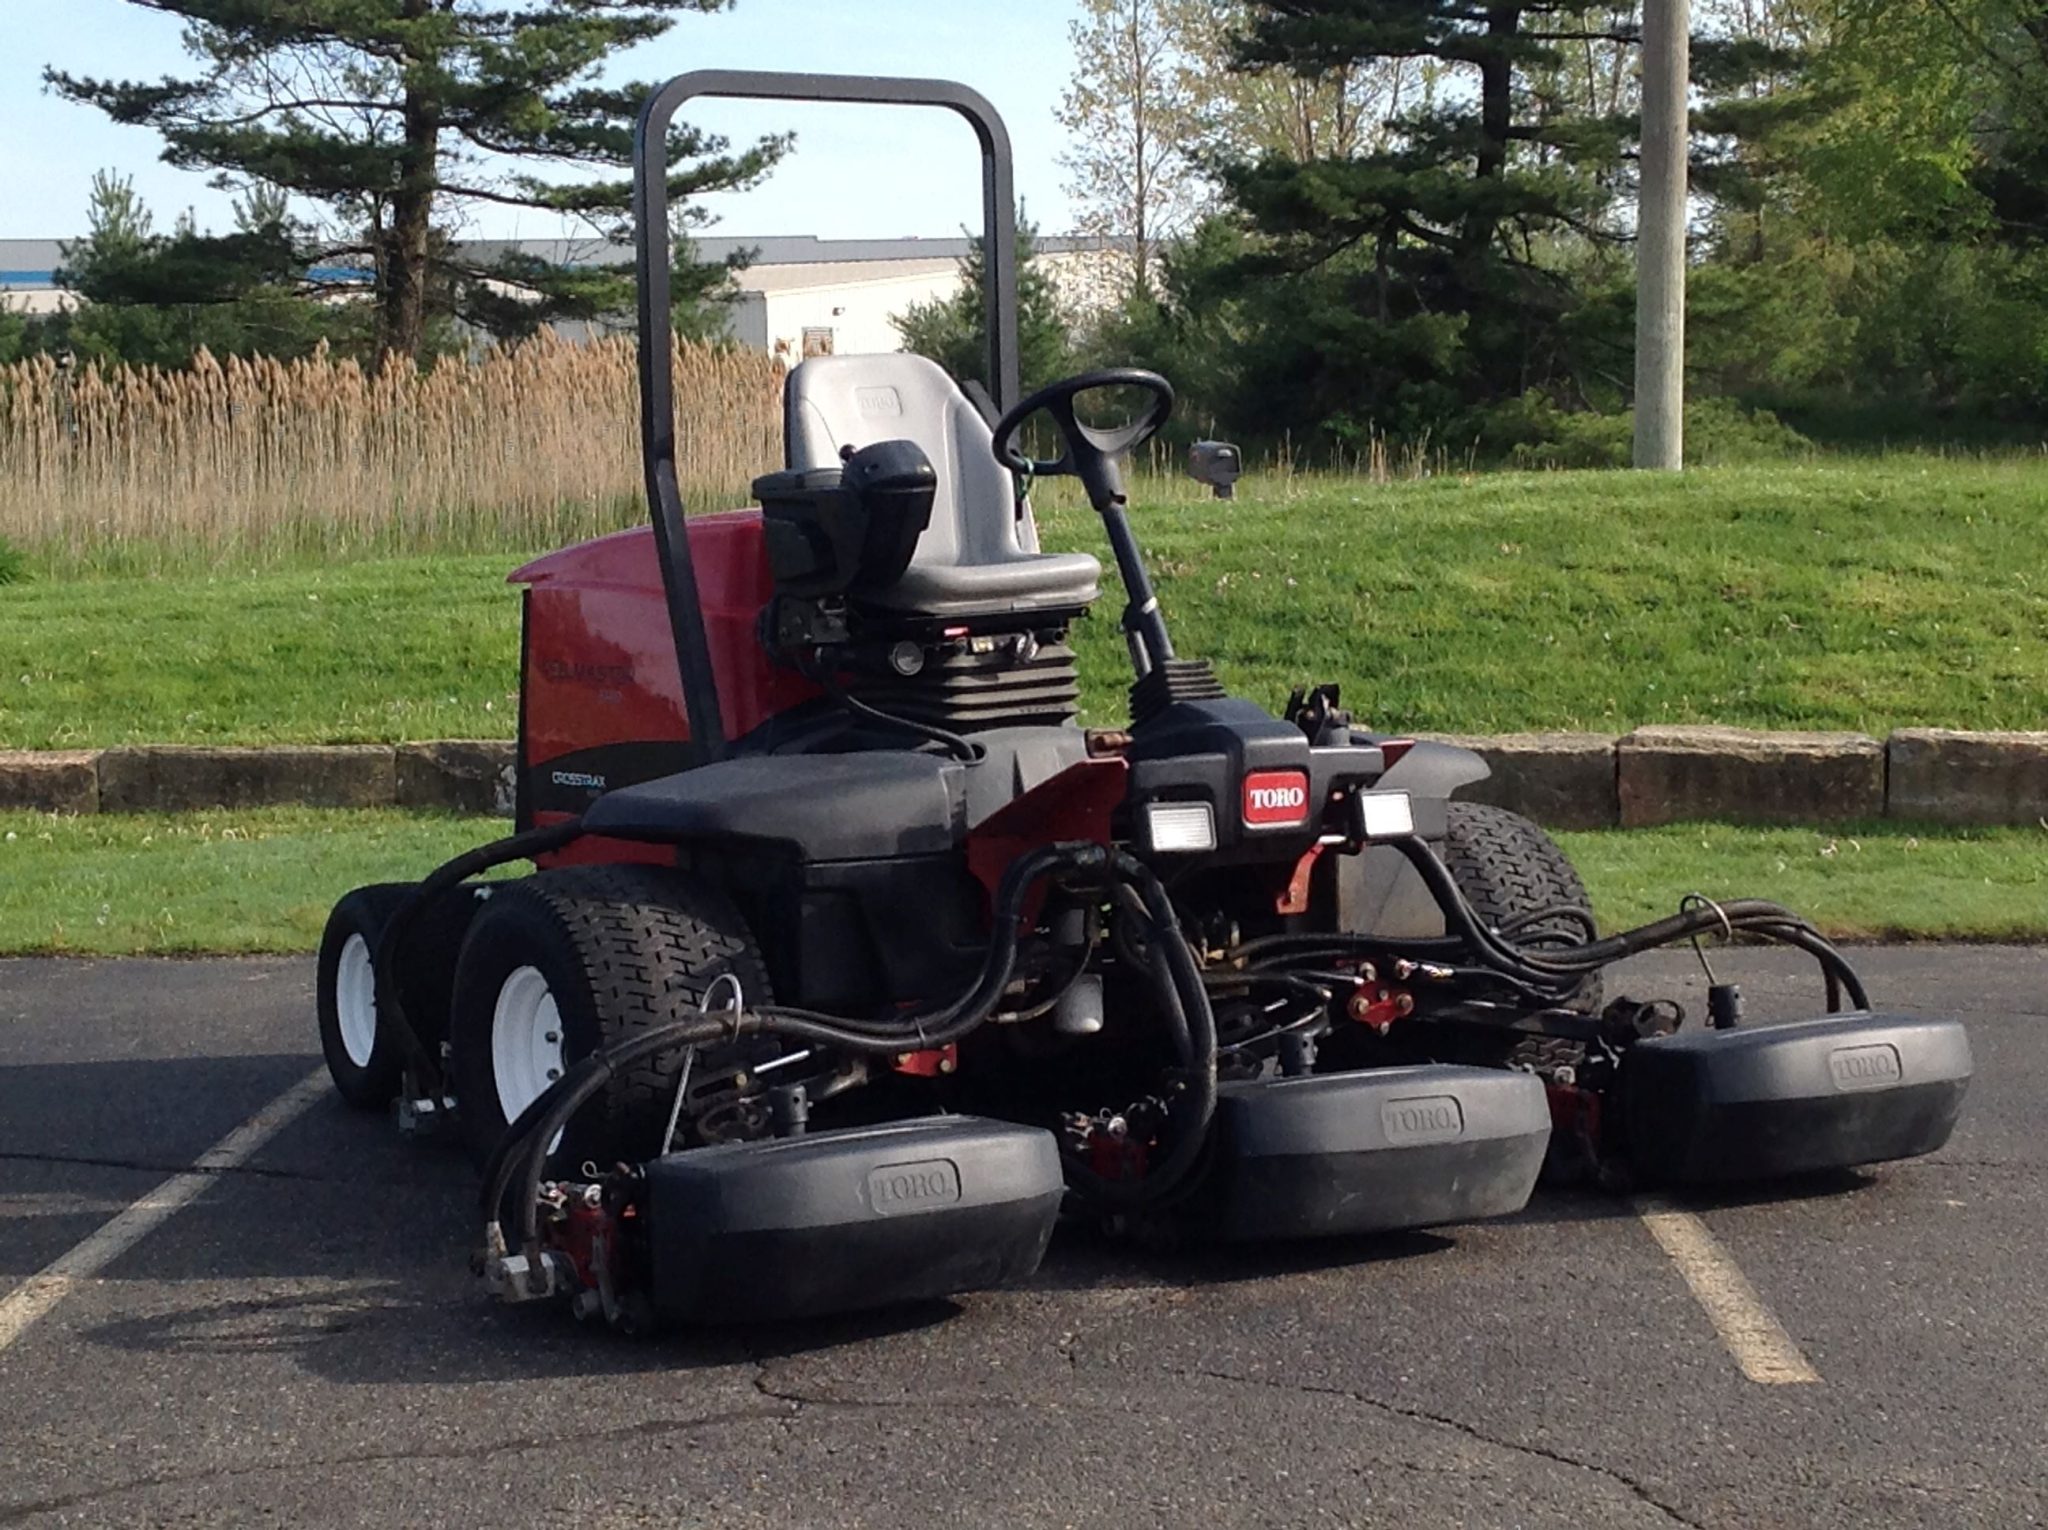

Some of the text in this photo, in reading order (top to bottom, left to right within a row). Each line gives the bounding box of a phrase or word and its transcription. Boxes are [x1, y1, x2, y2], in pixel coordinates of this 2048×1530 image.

[1250, 787, 1304, 809] TORO
[1833, 1054, 1889, 1080] TORO
[1384, 1106, 1450, 1133] TORO
[874, 1171, 945, 1202] TORO
